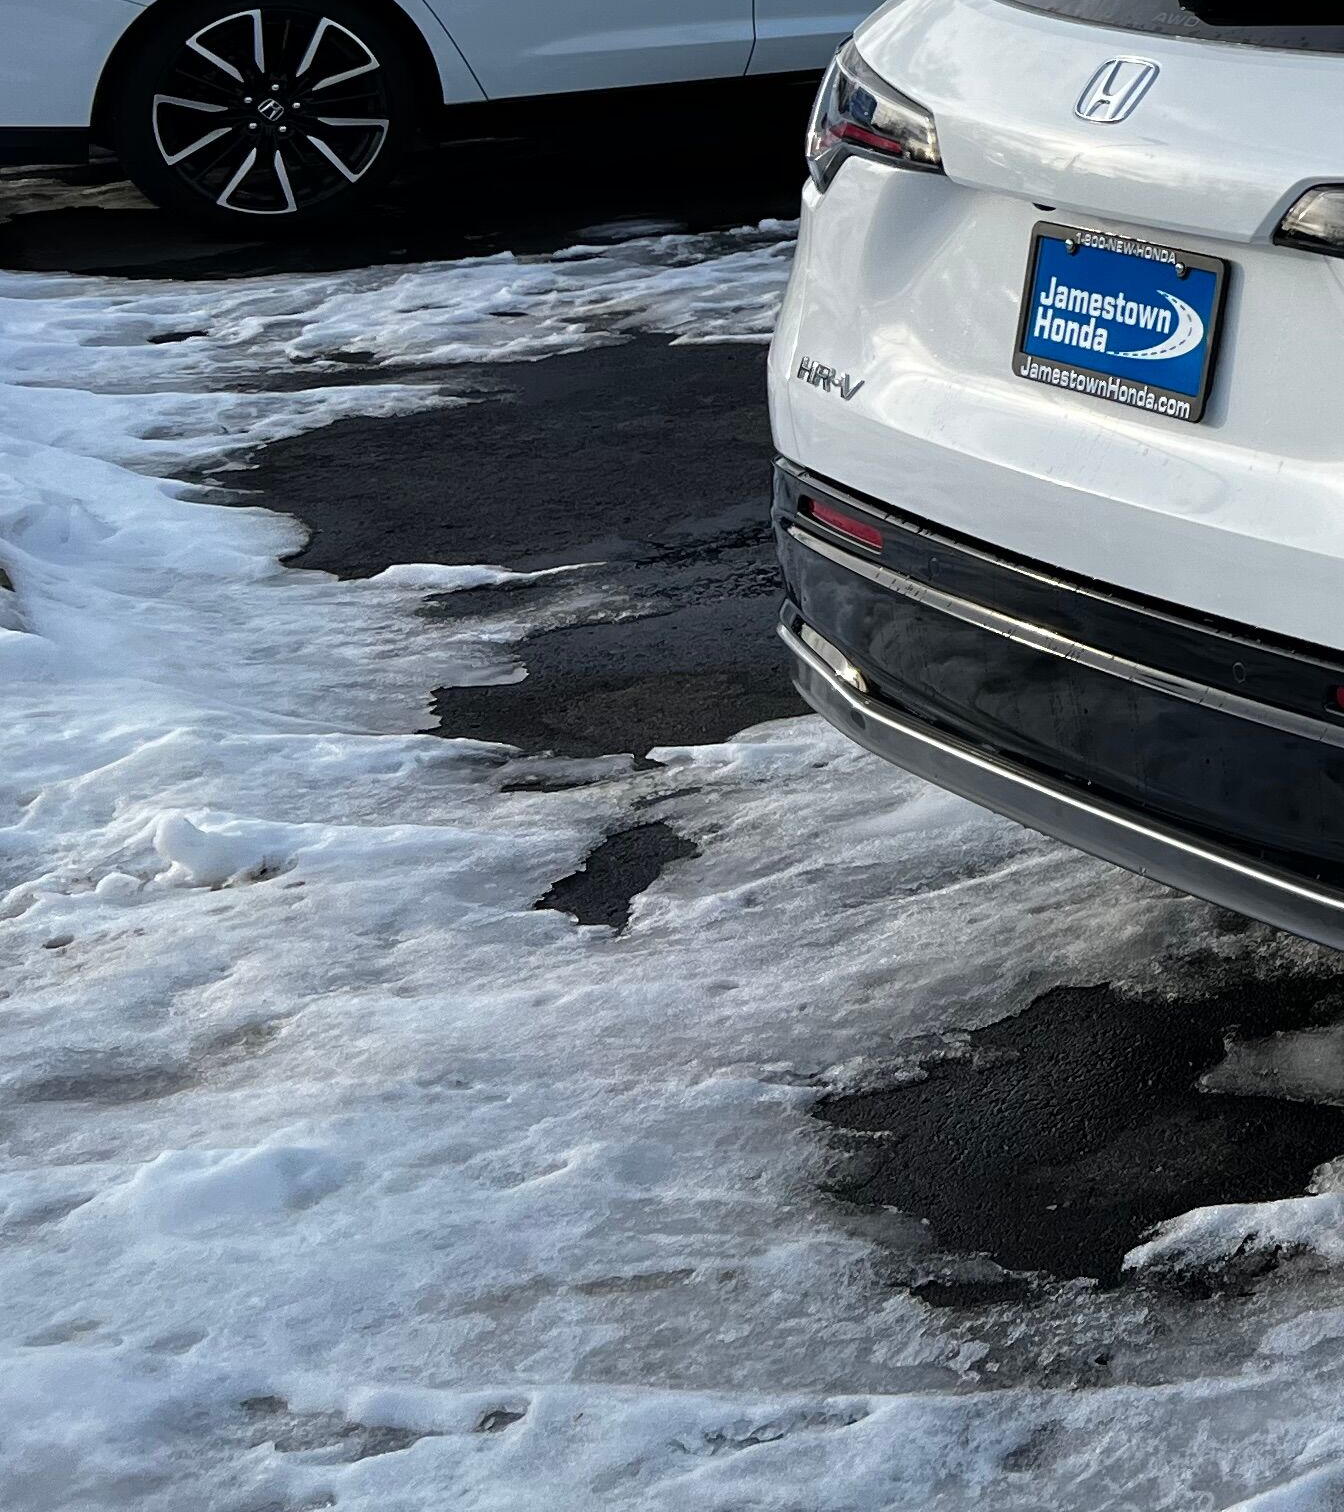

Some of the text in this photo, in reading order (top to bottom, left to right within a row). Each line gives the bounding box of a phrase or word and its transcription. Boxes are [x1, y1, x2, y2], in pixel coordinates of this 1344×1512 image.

[1151, 12, 1200, 27] AWD
[1074, 232, 1176, 265] 1-800-NEW-HONDA
[1040, 276, 1172, 334] Jamestown
[1033, 306, 1108, 353] Honda
[797, 356, 866, 401] HR-V
[1020, 355, 1191, 419] JamestownHonda.com
